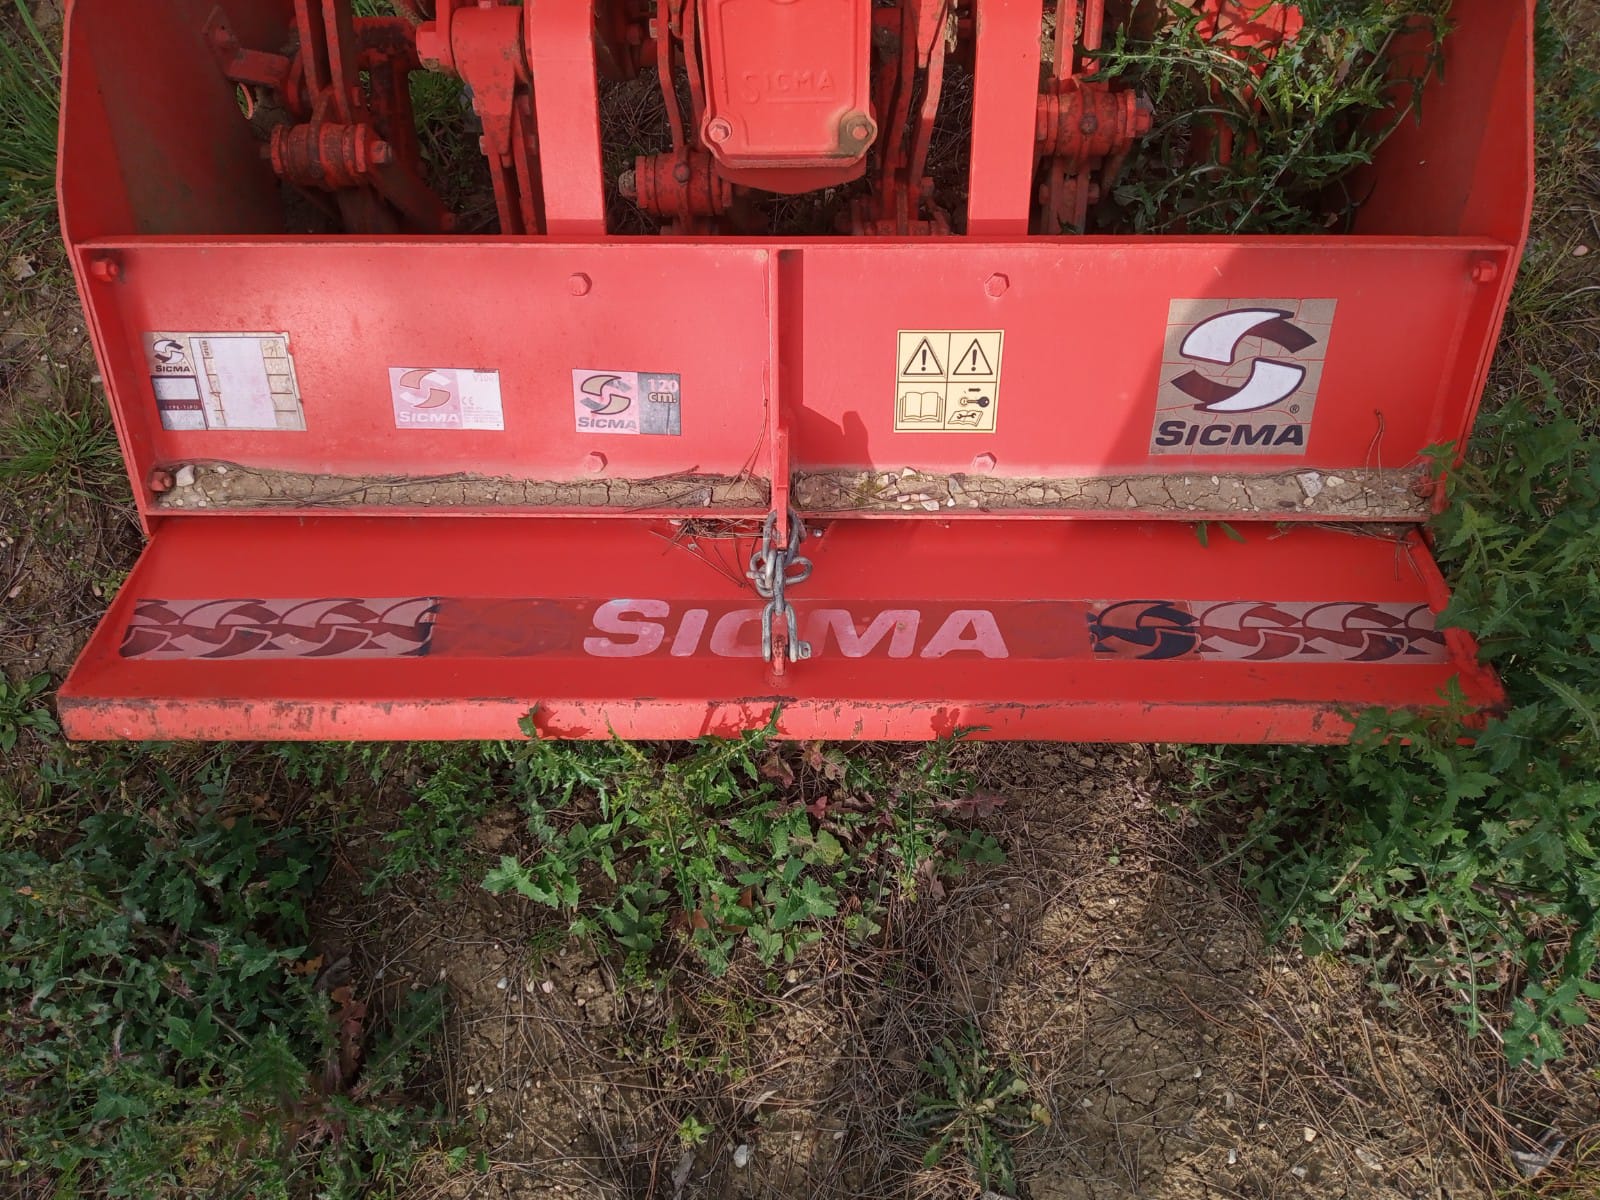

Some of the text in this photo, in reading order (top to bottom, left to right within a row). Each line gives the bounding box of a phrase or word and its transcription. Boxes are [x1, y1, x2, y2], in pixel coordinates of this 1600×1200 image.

[741, 69, 836, 105] SICMA
[155, 364, 191, 373] SICMA
[647, 378, 679, 393] 120
[647, 391, 677, 404] cm.
[398, 411, 461, 424] SICMA
[578, 416, 638, 430] SICMA
[1154, 420, 1304, 447] SICMA
[582, 598, 1010, 660] SICMA
